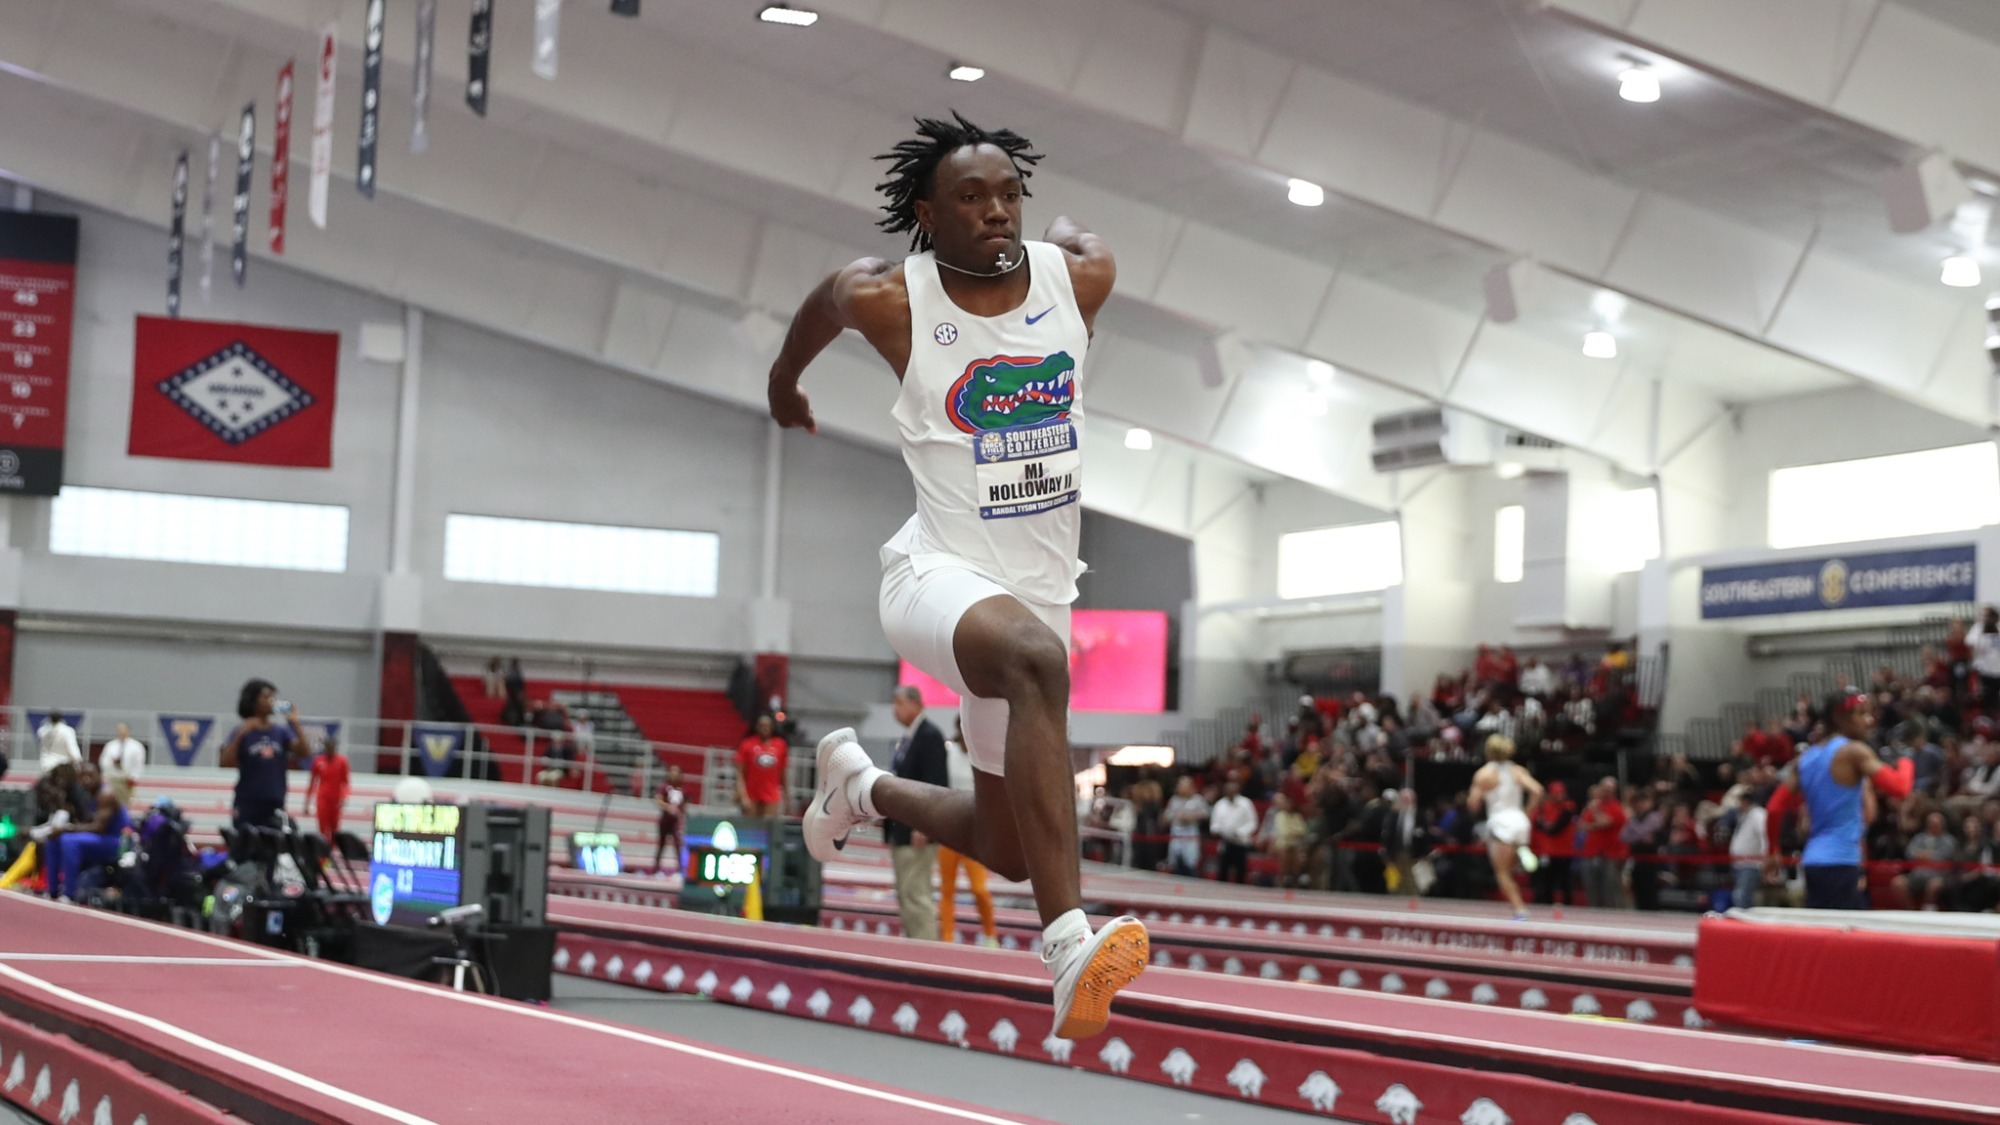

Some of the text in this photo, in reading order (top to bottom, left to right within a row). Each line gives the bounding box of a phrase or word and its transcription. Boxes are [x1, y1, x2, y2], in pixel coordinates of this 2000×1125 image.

[936, 323, 957, 344] SEC
[1005, 423, 1070, 442] SOUTHEASTERN
[1007, 433, 1070, 453] CONFERENCE
[1024, 462, 1043, 480] MJ
[989, 473, 1072, 501] HOLLOWAY II
[991, 506, 1016, 516] RANDAL
[1017, 503, 1036, 513] TYSON
[1037, 501, 1053, 510] TRACK
[1704, 576, 1813, 606] SOUTHEASTERN
[1851, 562, 1972, 593] CONFERENCE
